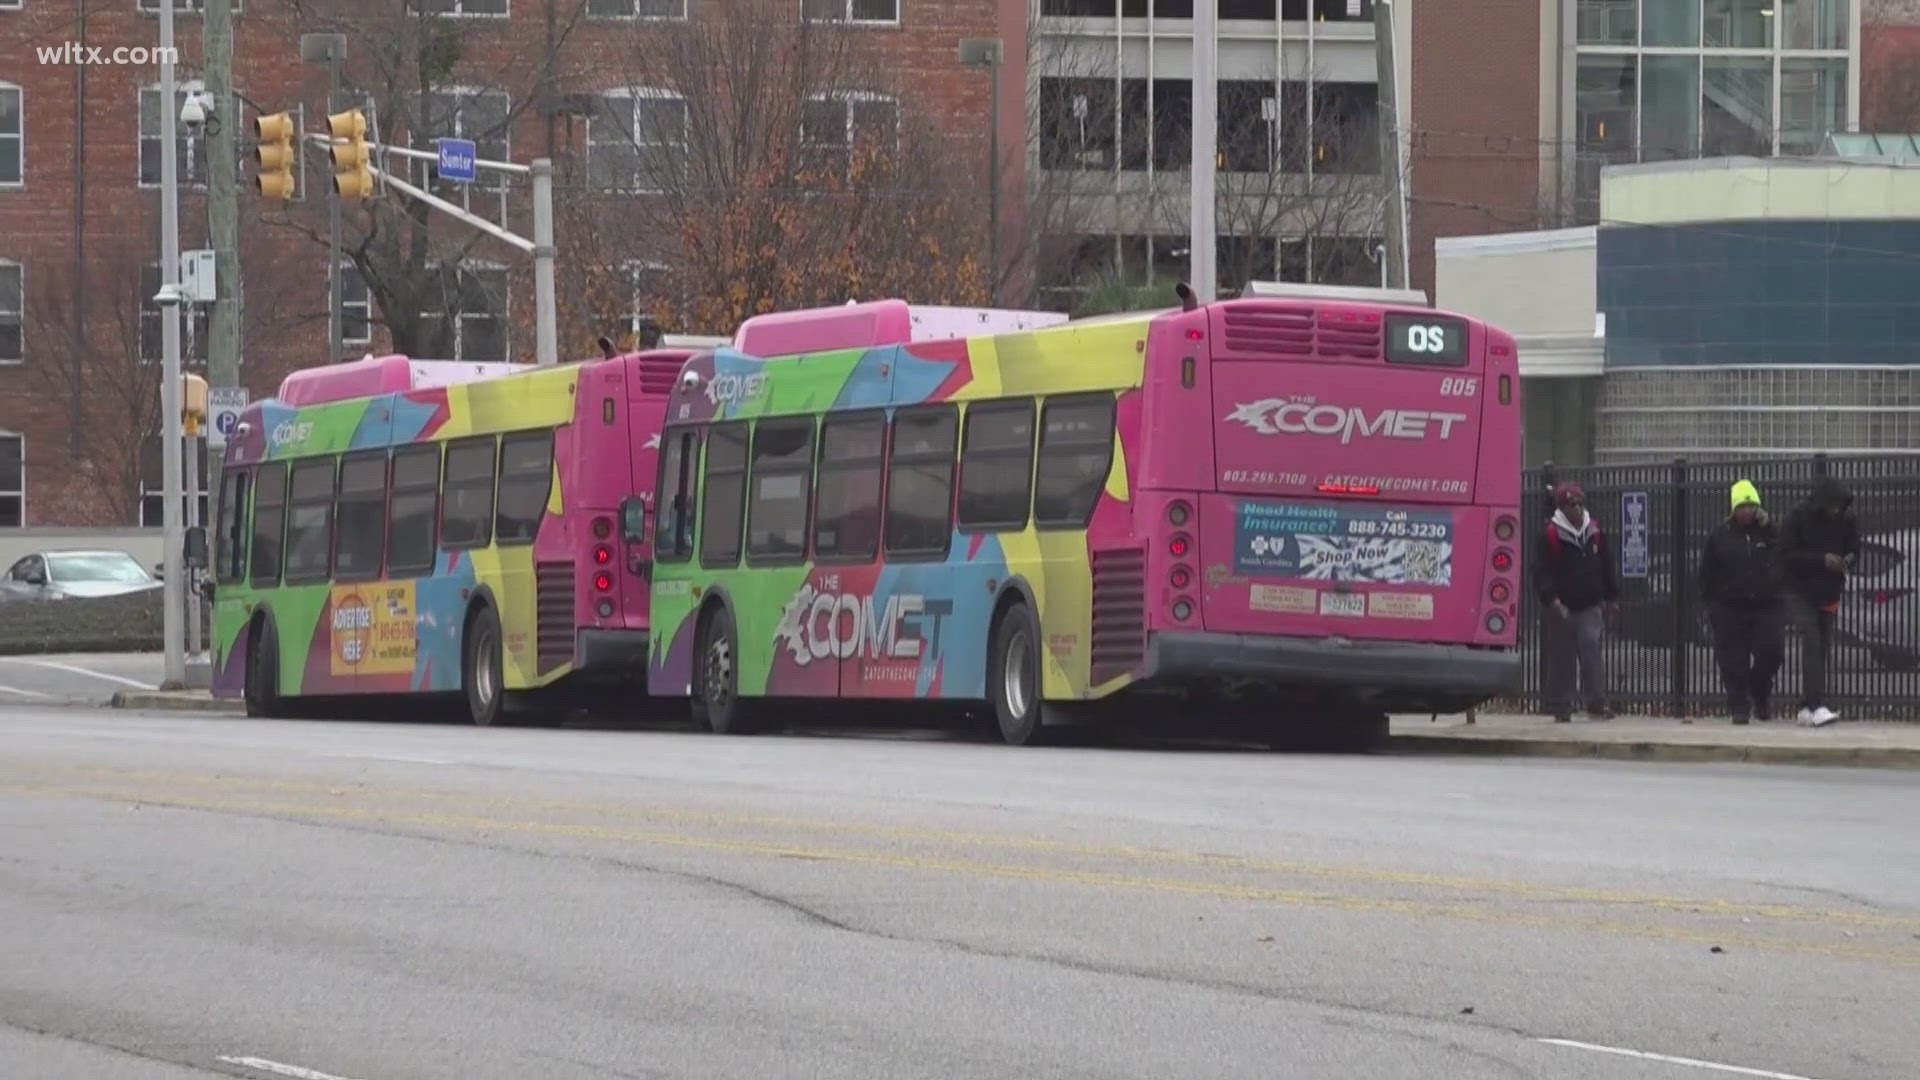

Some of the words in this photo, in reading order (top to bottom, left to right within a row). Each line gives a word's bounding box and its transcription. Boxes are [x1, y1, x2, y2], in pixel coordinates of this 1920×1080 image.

[441, 148, 471, 171] Sumter
[1408, 325, 1444, 352] OS
[716, 371, 769, 407] COMET
[1440, 377, 1477, 397] 805
[1275, 404, 1467, 444] COMET
[1244, 503, 1284, 516] Need
[1287, 506, 1338, 518] Health
[1386, 511, 1407, 521] Call
[1243, 515, 1337, 532] Insurance?
[1348, 520, 1446, 538] 888-745-3230
[1316, 551, 1352, 566] Shop
[1356, 547, 1389, 560] Now
[333, 607, 371, 631] ADVERTISE
[807, 594, 953, 660] COMET
[342, 639, 362, 661] HERE
